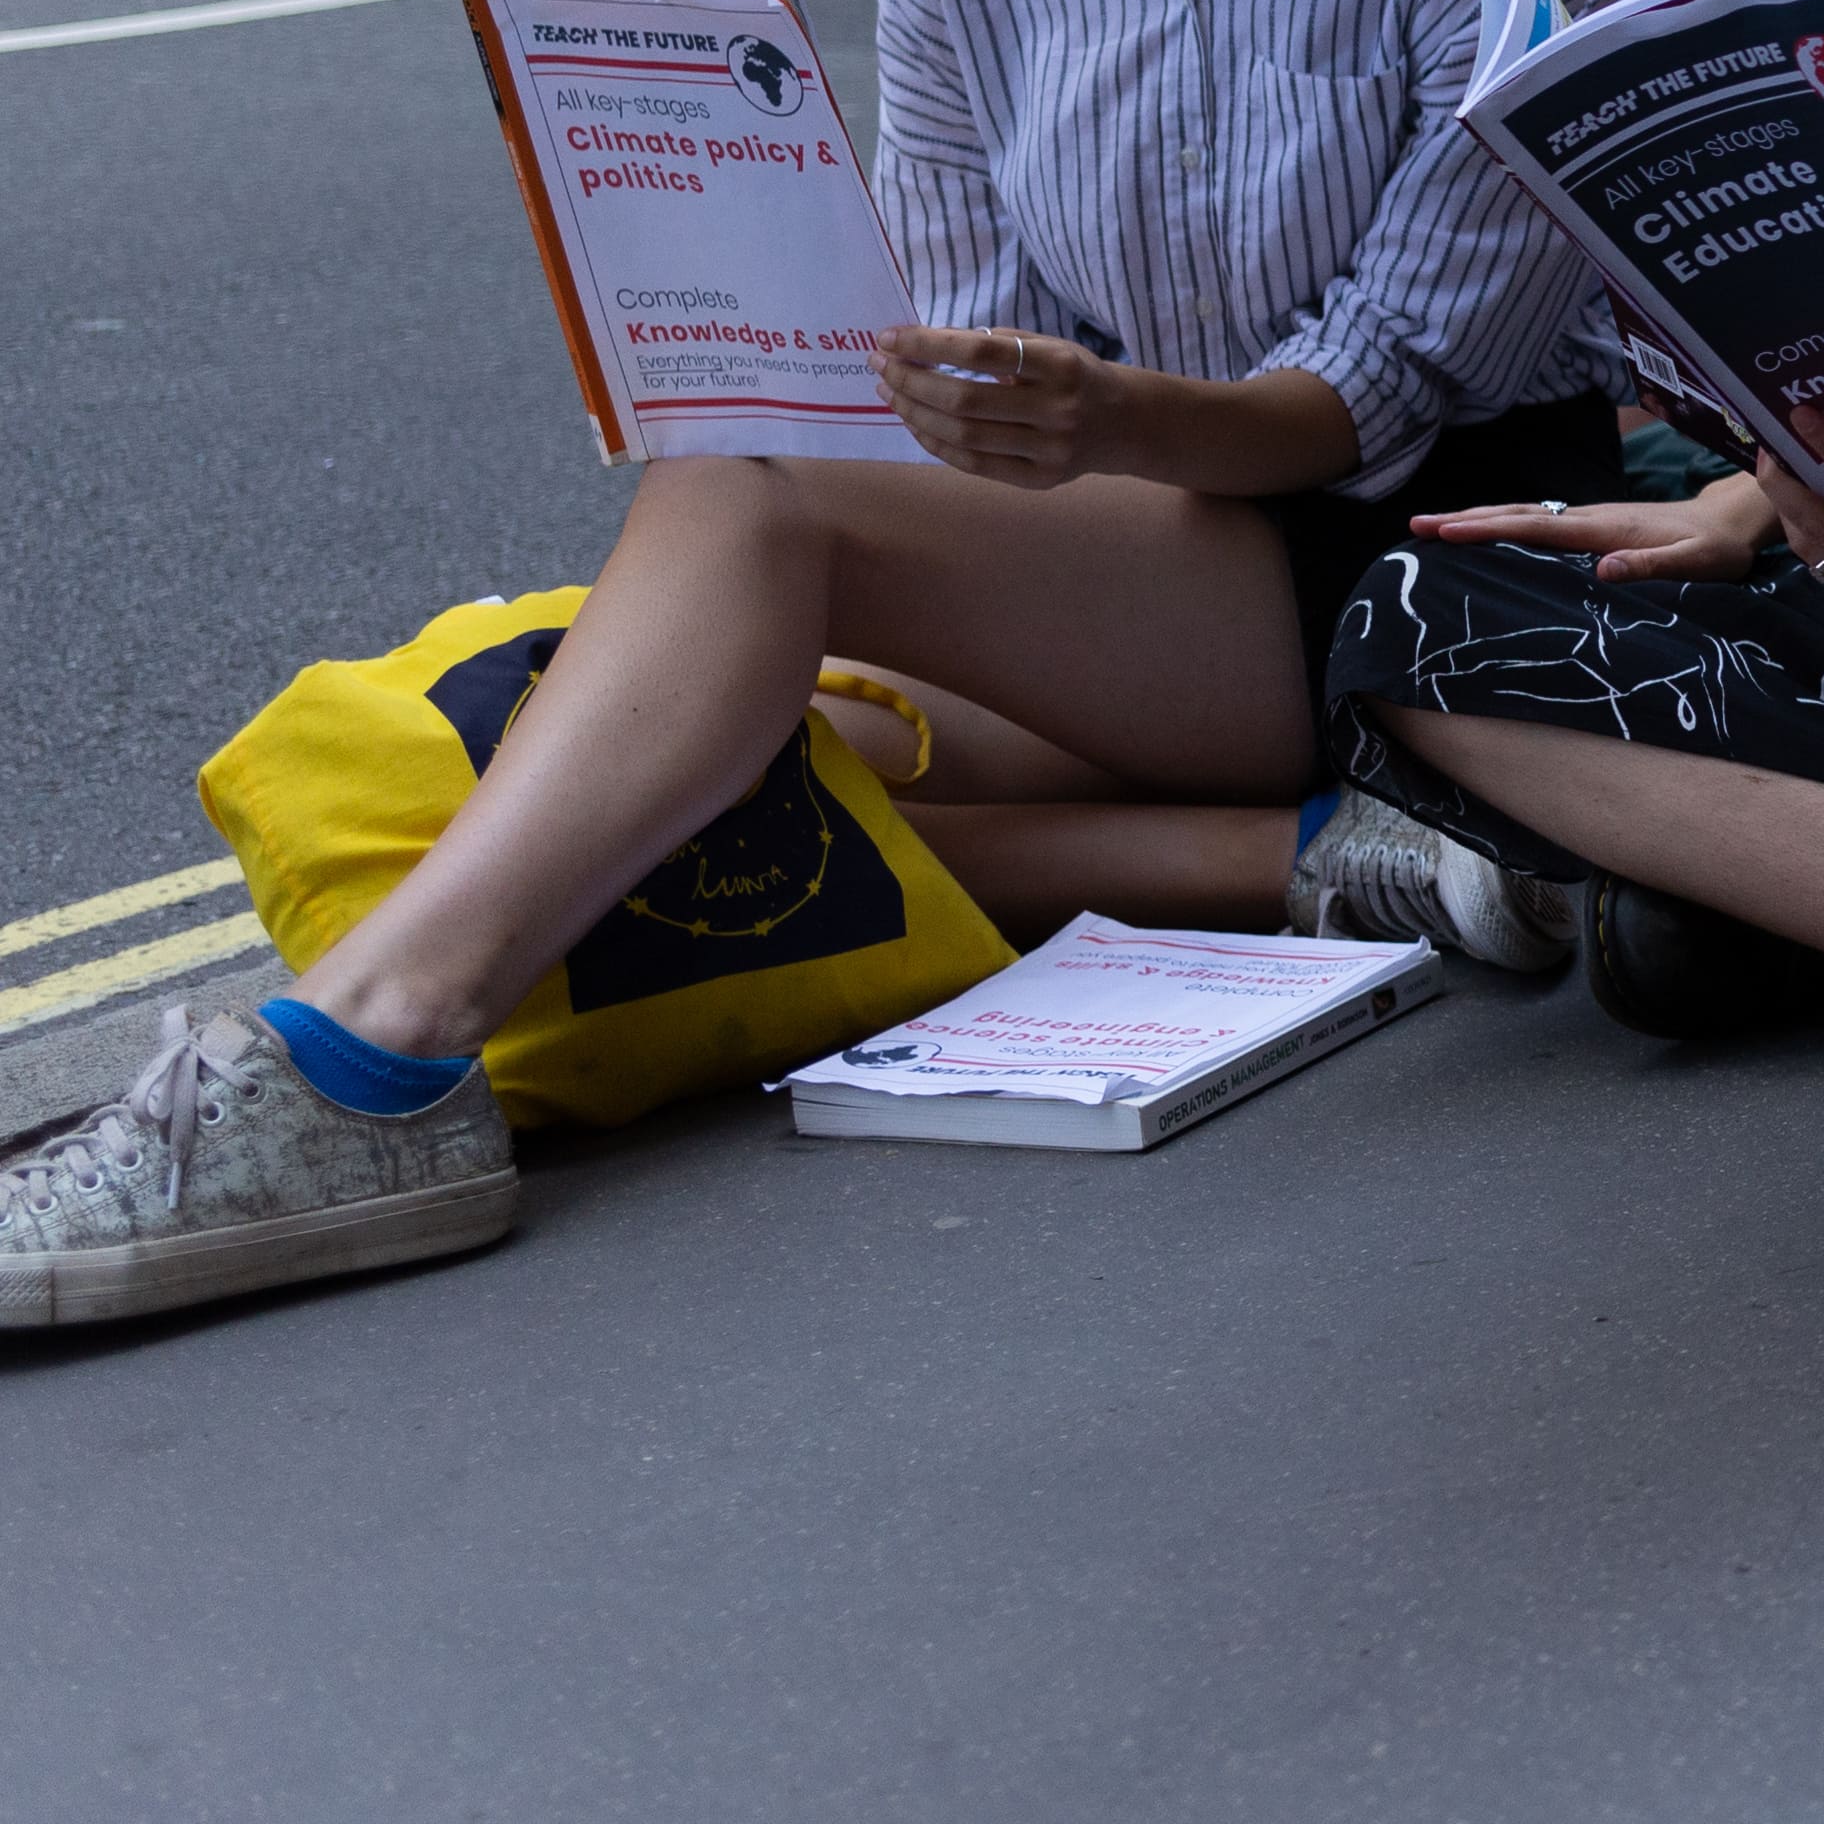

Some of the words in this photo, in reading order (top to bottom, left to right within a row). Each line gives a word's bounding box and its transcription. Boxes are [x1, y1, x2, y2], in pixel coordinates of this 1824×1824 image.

[533, 24, 598, 45] TEACH
[602, 29, 640, 48] THE
[645, 32, 720, 52] FUTURE
[556, 89, 582, 111] All
[589, 90, 711, 123] key-stages
[1547, 90, 1640, 156] TEACH
[1640, 68, 1693, 102] THE
[1696, 42, 1788, 83] FUTURE
[567, 124, 697, 156] Climate
[705, 135, 804, 172] policy
[817, 140, 839, 166] &
[1603, 174, 1642, 211] All
[1638, 119, 1801, 186] key-stages
[578, 162, 704, 198] politics
[1634, 161, 1818, 244] Climate
[617, 287, 739, 314] Complete
[626, 320, 787, 353] Knowledge
[793, 329, 813, 351] &
[817, 329, 879, 352] skill
[637, 353, 723, 373] Everything
[724, 356, 752, 371] you
[755, 357, 789, 372] need
[792, 360, 808, 375] to
[811, 362, 876, 378] prepare
[643, 373, 668, 389] for
[670, 375, 706, 391] your
[1055, 960, 1134, 970] skills
[1137, 966, 1160, 976] &
[1164, 968, 1337, 986] Knowledge
[1185, 983, 1314, 997] Complete
[905, 1021, 1051, 1044] science
[972, 1010, 1202, 1037] engineering
[1209, 1028, 1236, 1039] &
[1059, 1035, 1208, 1050] Climate
[906, 1065, 997, 1077] FUTURE
[1158, 1078, 1229, 1132] OPERATIONS
[1230, 1034, 1306, 1088] MANAGEMENT
